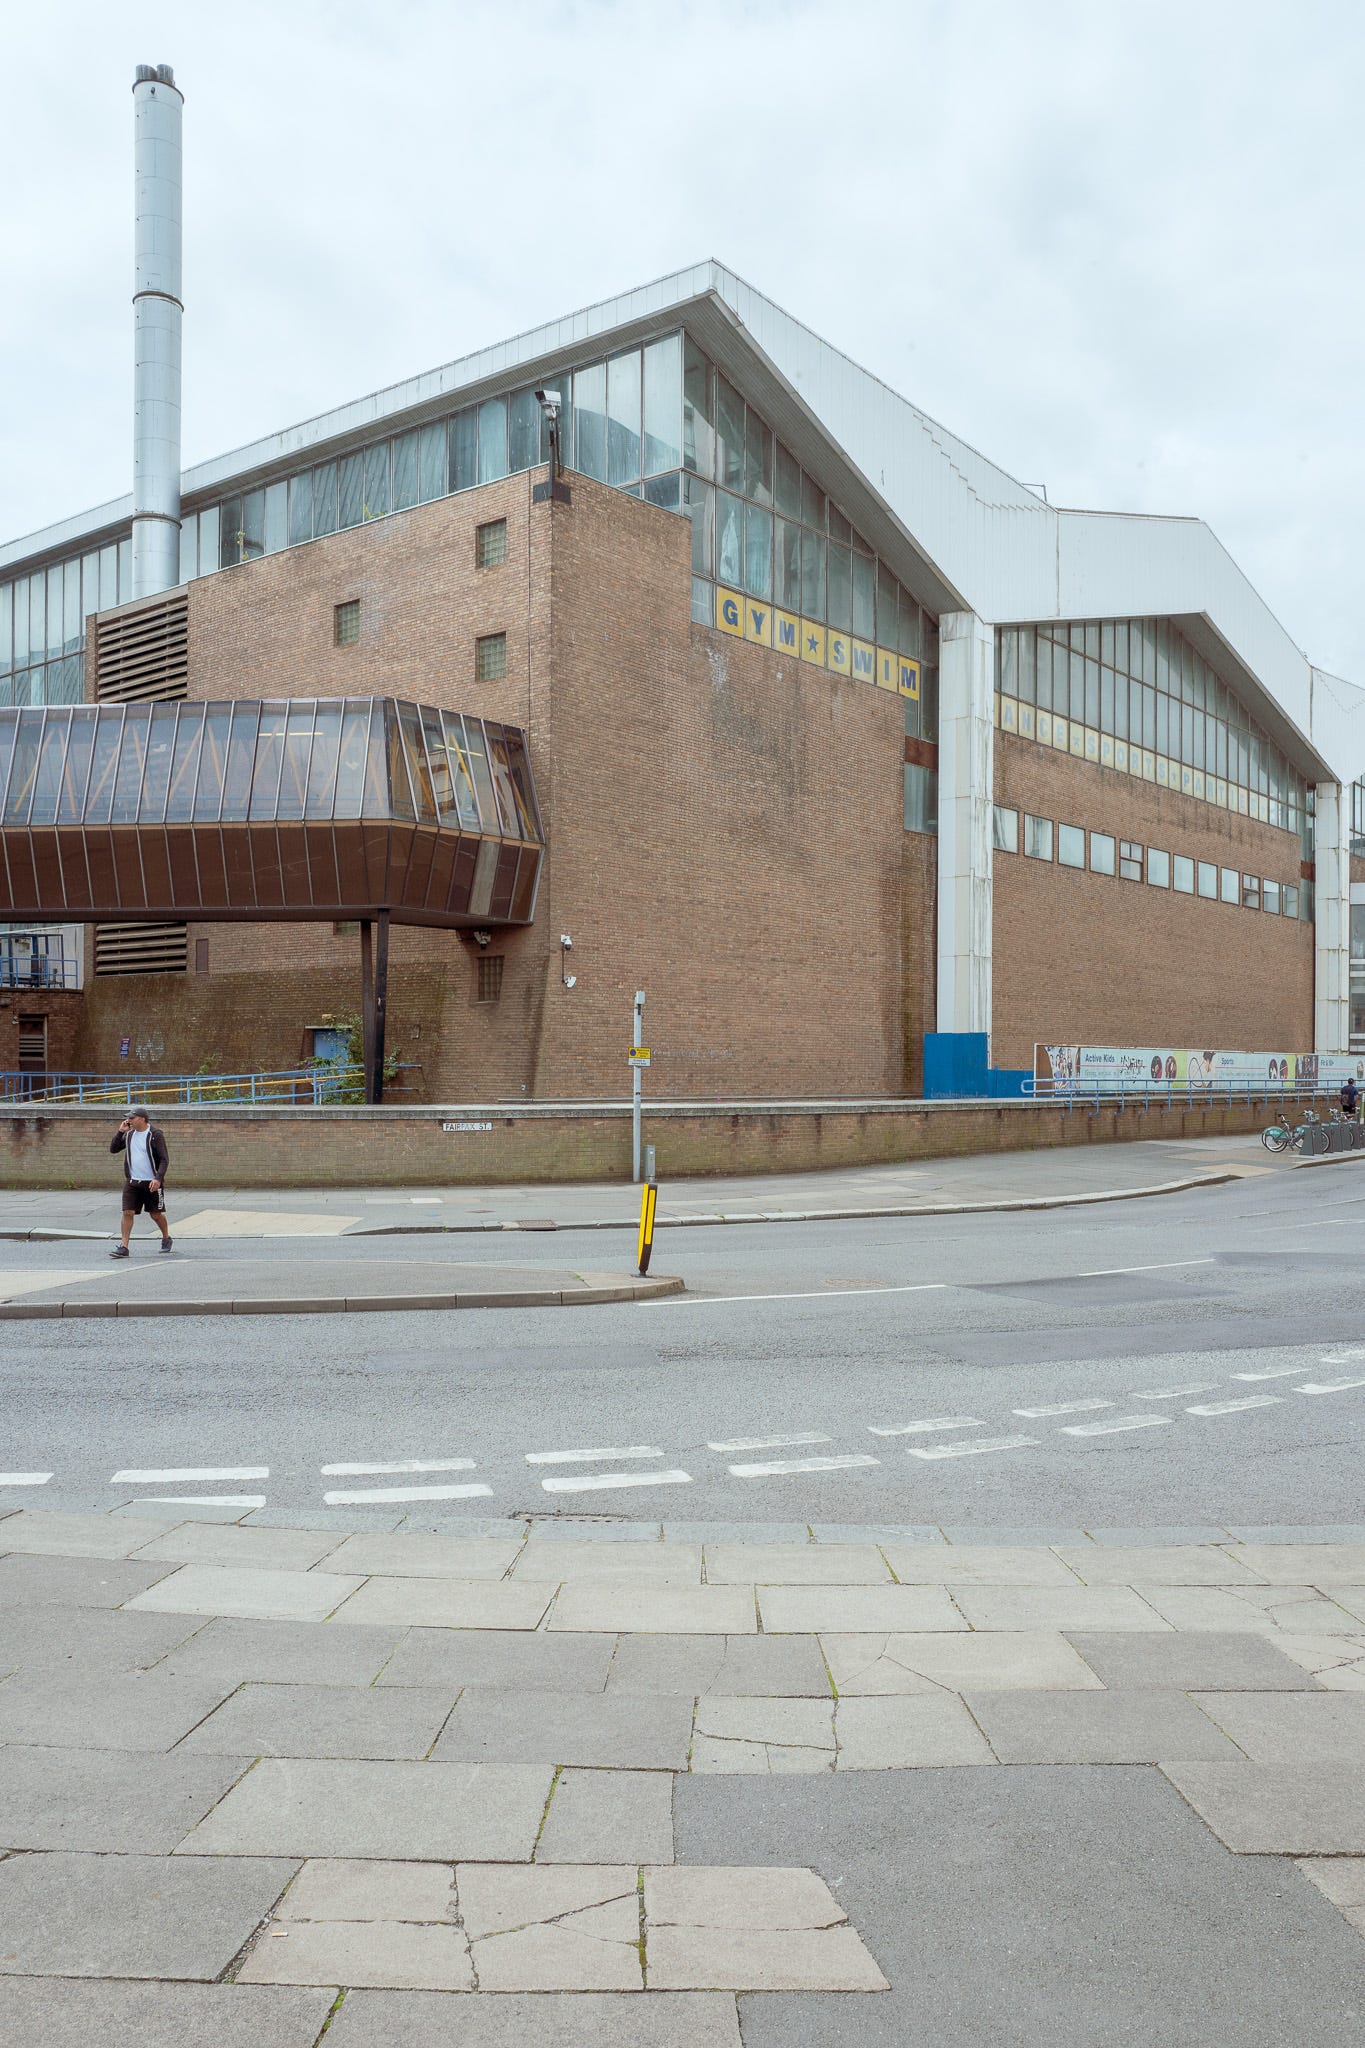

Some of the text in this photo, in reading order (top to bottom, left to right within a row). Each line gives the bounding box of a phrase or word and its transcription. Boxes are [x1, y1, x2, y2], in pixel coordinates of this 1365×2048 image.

[723, 600, 917, 691] GYM SWIM
[1004, 703, 1065, 744] ANCE
[1087, 735, 1166, 779] SPORTS
[1085, 1053, 1115, 1063] Active Kids
[445, 1123, 476, 1131] FAIRFAX
